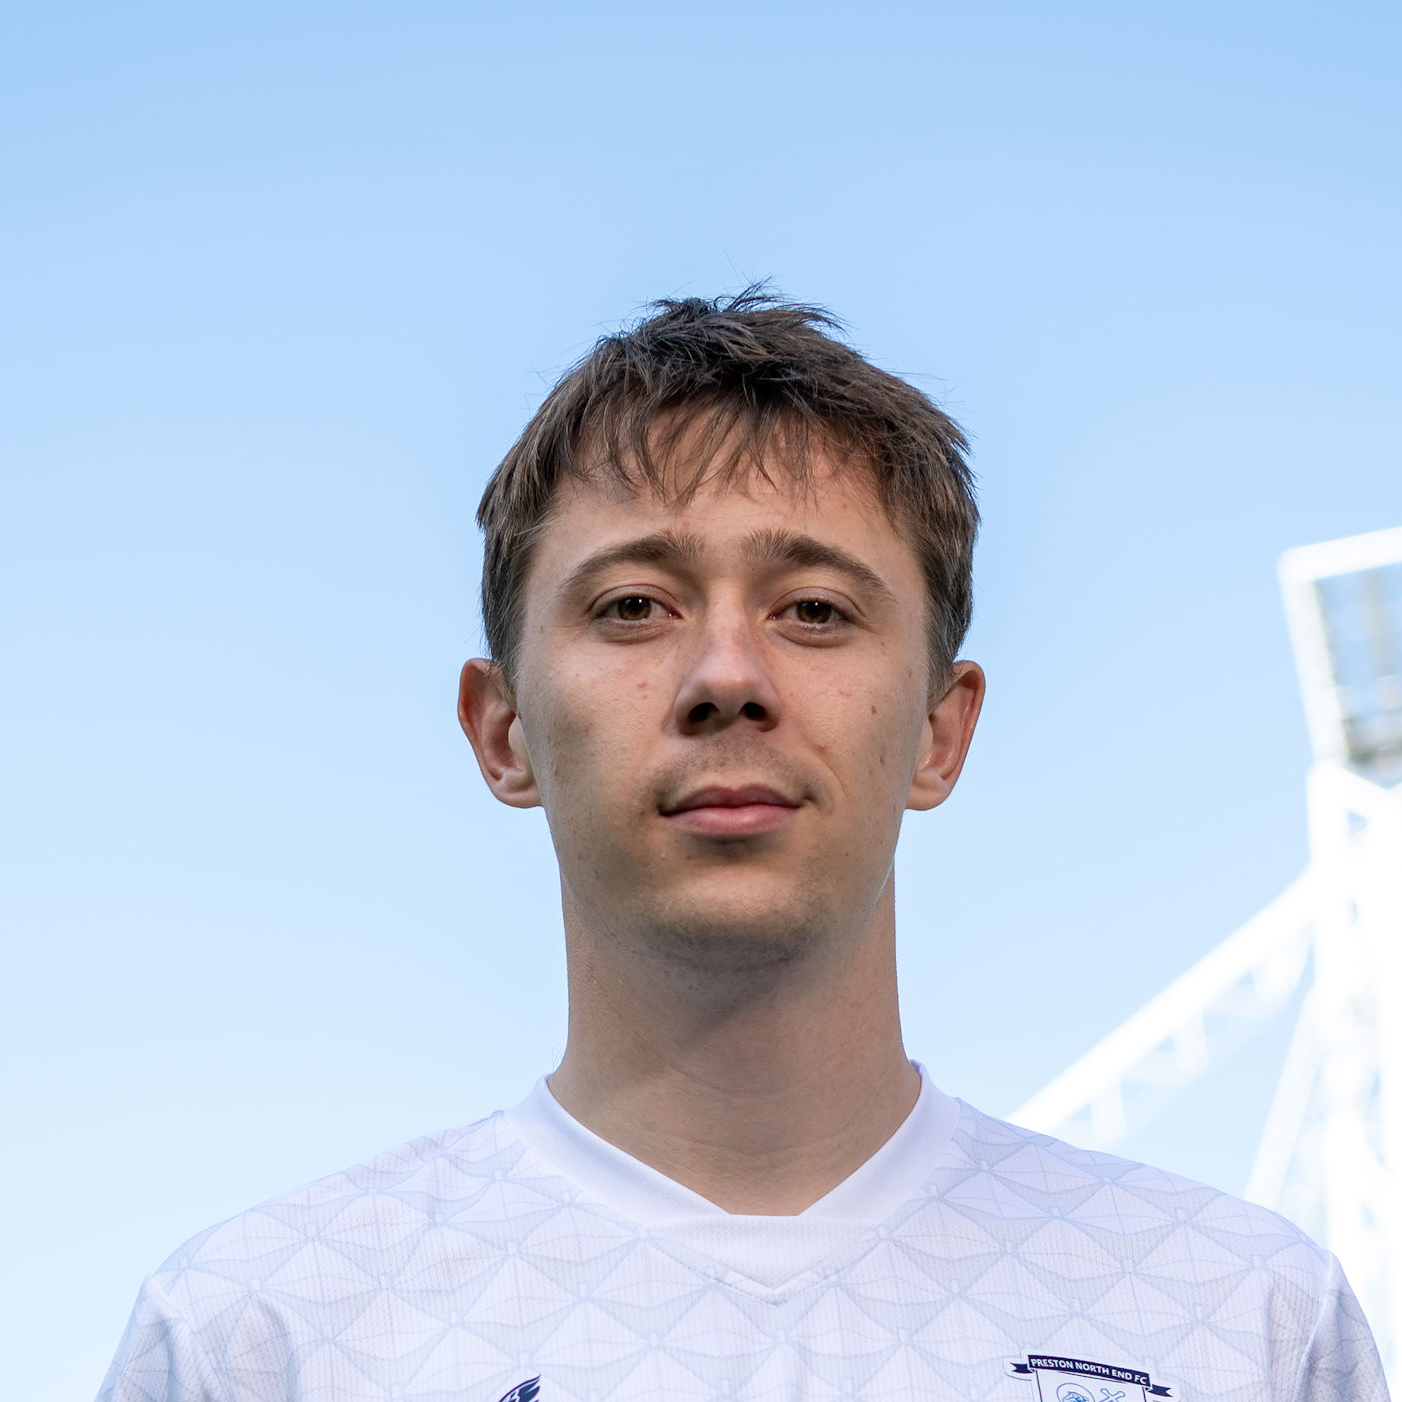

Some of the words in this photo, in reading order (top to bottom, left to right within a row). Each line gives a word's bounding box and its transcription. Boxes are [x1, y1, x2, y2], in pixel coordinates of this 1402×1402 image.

[1030, 1358, 1074, 1370] PRESTON
[1075, 1362, 1110, 1375] NORTH
[1111, 1369, 1133, 1380] END
[1134, 1373, 1148, 1385] FC
